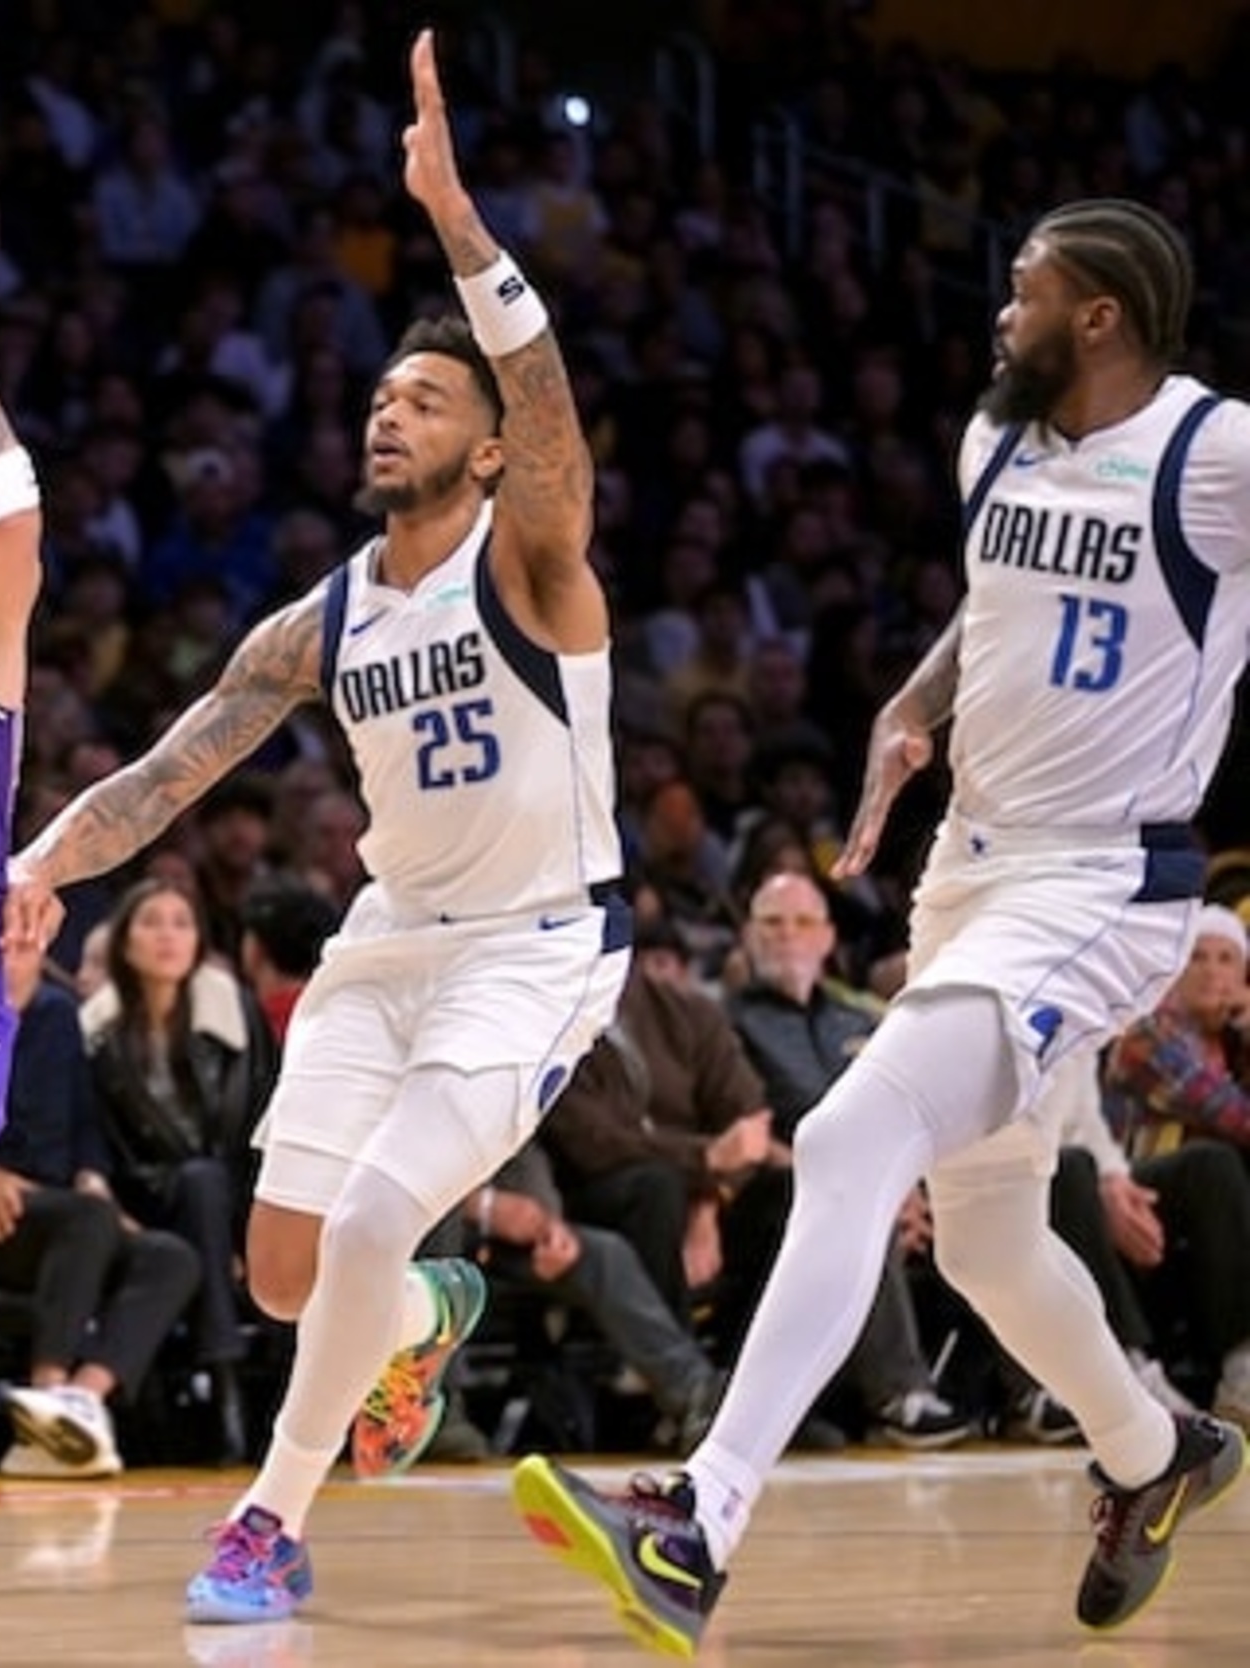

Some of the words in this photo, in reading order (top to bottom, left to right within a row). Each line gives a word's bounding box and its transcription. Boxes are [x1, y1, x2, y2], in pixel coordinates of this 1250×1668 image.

[979, 502, 1143, 584] DALLAS
[340, 631, 486, 724] DALLAS
[1050, 592, 1130, 693] 13
[412, 698, 502, 791] 25
